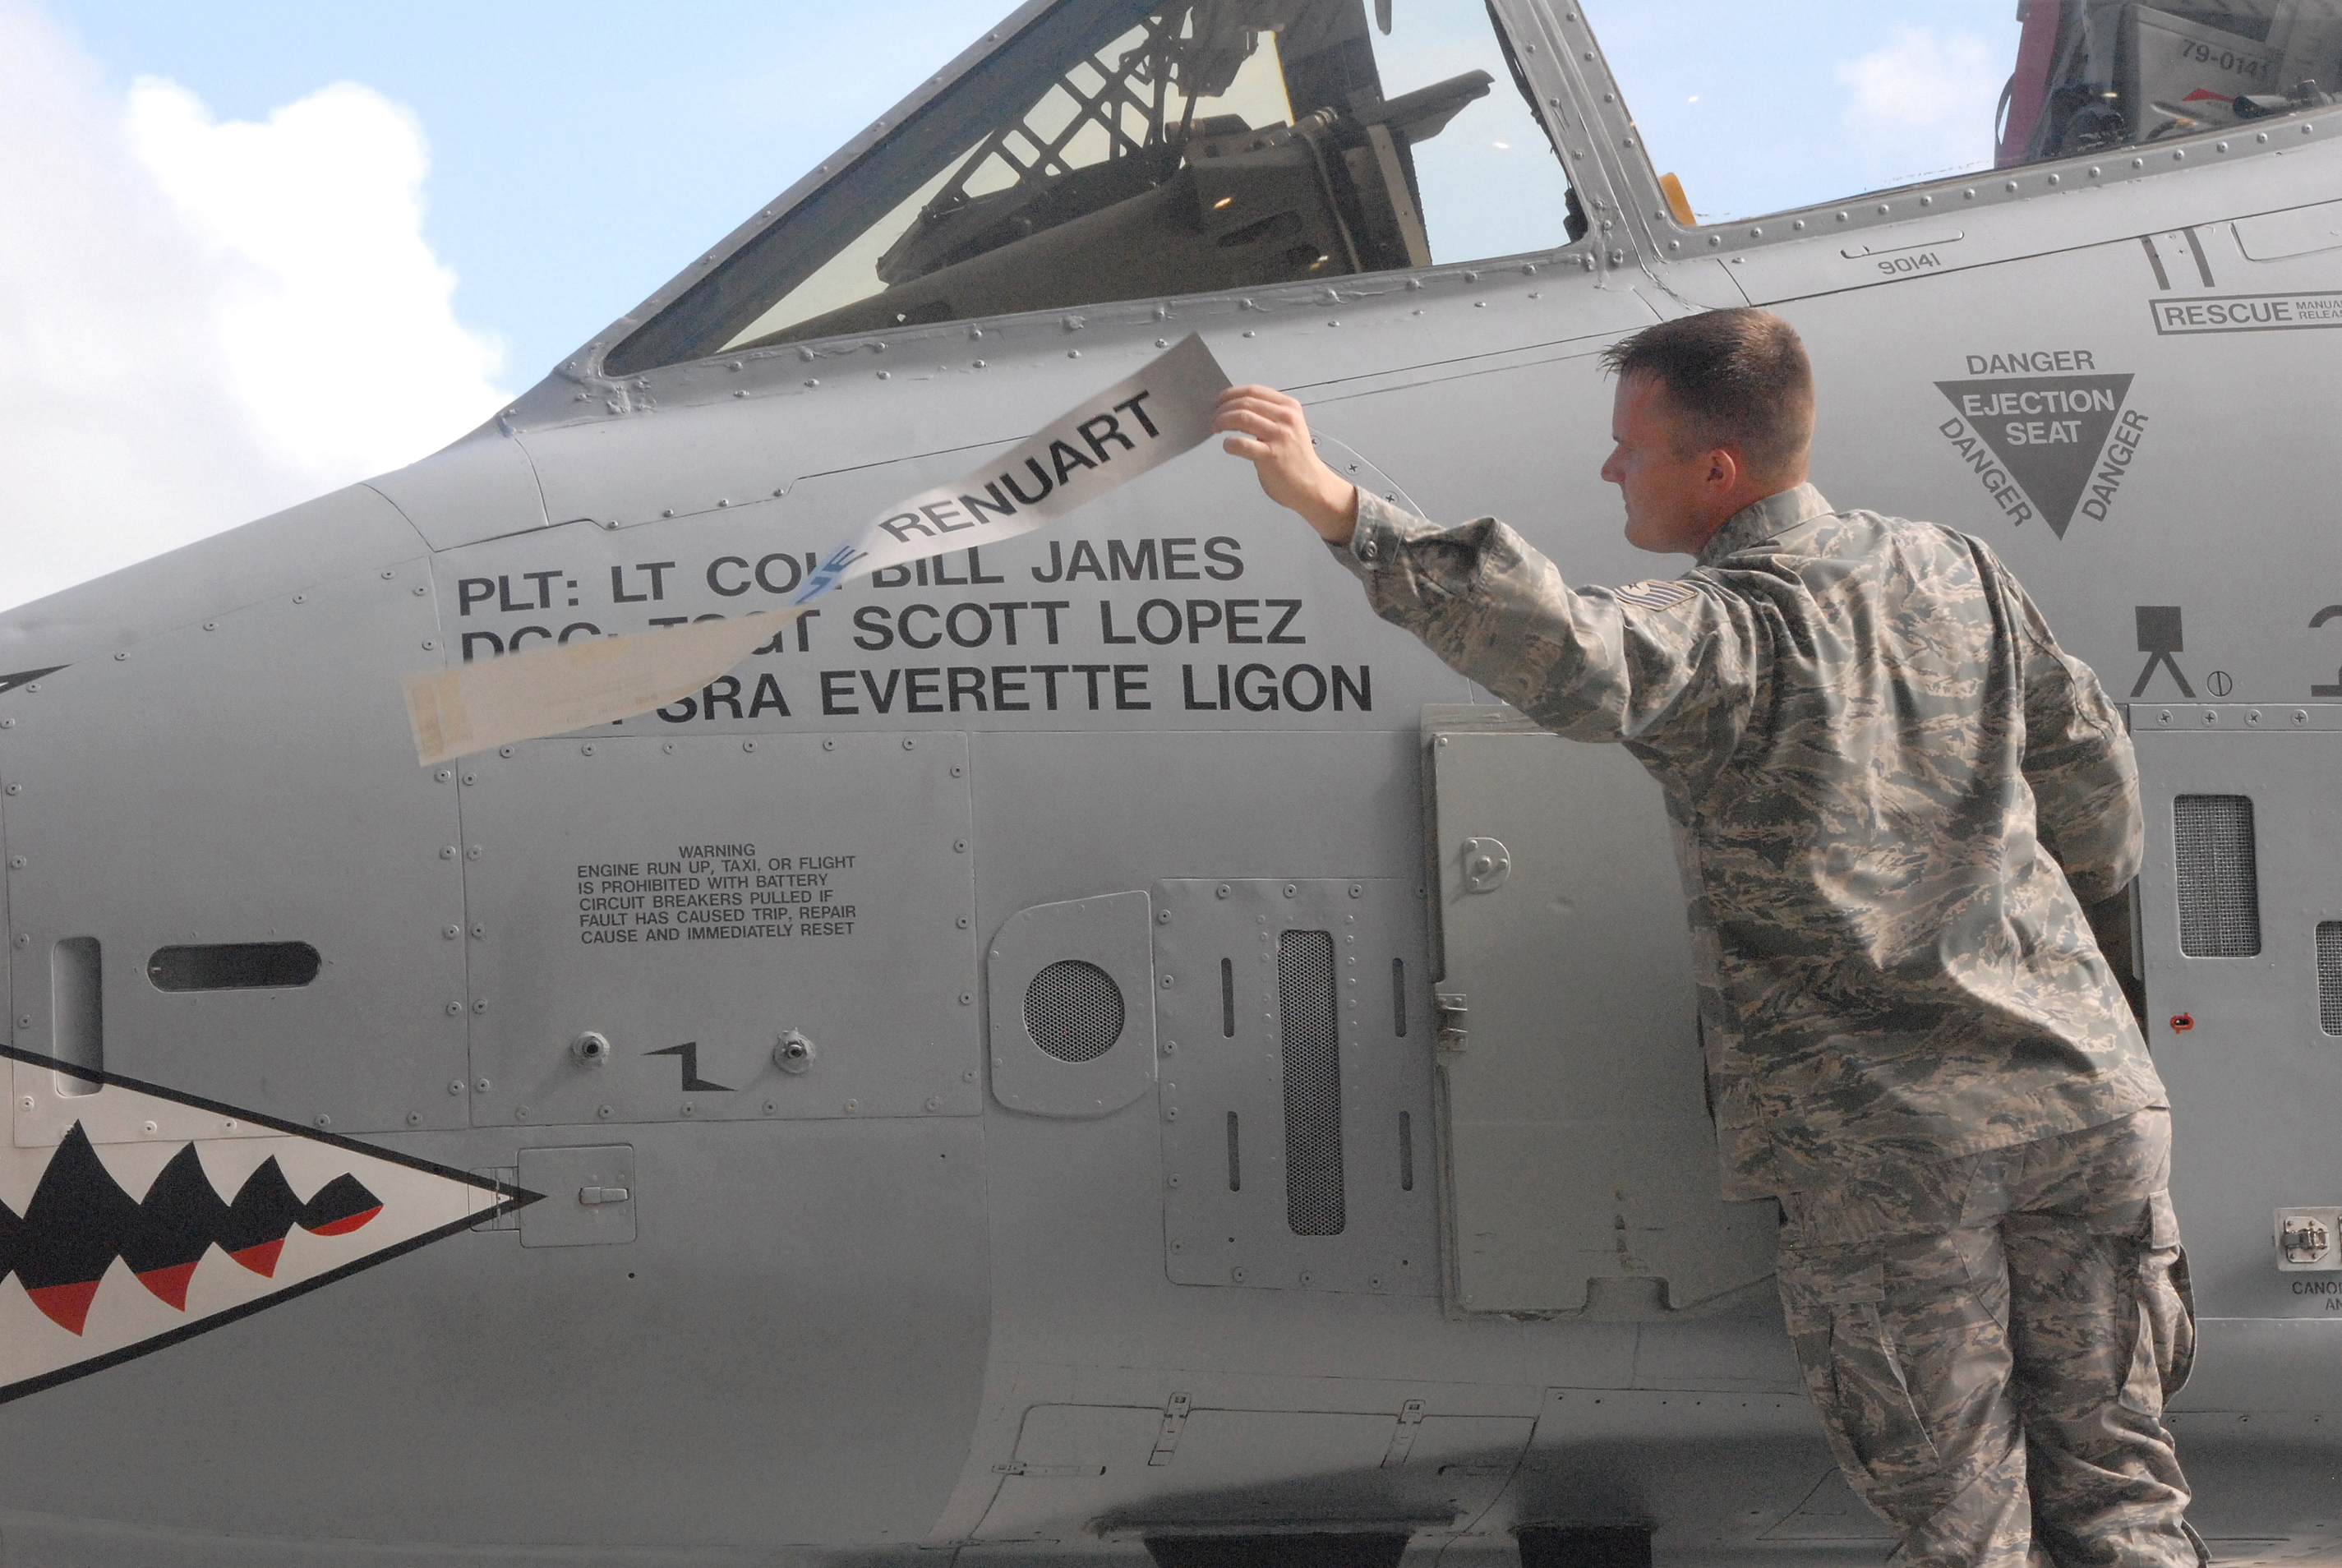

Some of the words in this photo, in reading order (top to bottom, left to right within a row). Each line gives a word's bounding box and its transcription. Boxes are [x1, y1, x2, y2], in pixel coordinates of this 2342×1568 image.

[2164, 302, 2293, 326] RESCUE
[2295, 300, 2342, 310] MANUA
[1966, 349, 2095, 375] DANGER
[1962, 389, 2115, 417] EJECTION
[2005, 420, 2082, 445] SEAT
[878, 390, 1160, 543] RENUART
[1938, 416, 2033, 528] DANGER
[2081, 409, 2149, 522] DANGER
[458, 570, 579, 616] PLT:
[611, 561, 675, 602] LT
[872, 546, 1004, 588] BILL
[1032, 536, 1244, 583] JAMES
[853, 601, 1069, 651] SCOTT
[1100, 599, 1306, 645] LOPEZ
[657, 673, 791, 723] SRA
[821, 664, 1151, 717] EVERETTE
[1183, 663, 1372, 712] LIGON
[679, 844, 755, 858] WARNING
[578, 864, 639, 878] ENGINE
[648, 862, 681, 875] RUN
[689, 860, 715, 876] UP,
[722, 859, 760, 873] TAXI,
[768, 858, 791, 871] OR
[799, 855, 856, 870] FLIGHT
[579, 881, 594, 894] IS
[602, 878, 700, 894] PROHIBITED
[708, 876, 749, 889] WITH
[756, 874, 828, 888] BATTERY
[579, 896, 645, 911] CIRCUIT
[653, 892, 742, 908] BREAKERS
[749, 890, 812, 905] PULLED
[820, 889, 833, 902] IF
[580, 913, 629, 927] FAULT
[635, 911, 669, 925] HAS
[677, 909, 745, 924] CAUSED
[752, 907, 792, 921] TRIP,
[800, 905, 856, 919] REPAIR
[581, 929, 638, 944] CAUSE
[646, 928, 680, 942] AND
[688, 924, 793, 940] IMMEDIATELY
[801, 922, 855, 936] RESET
